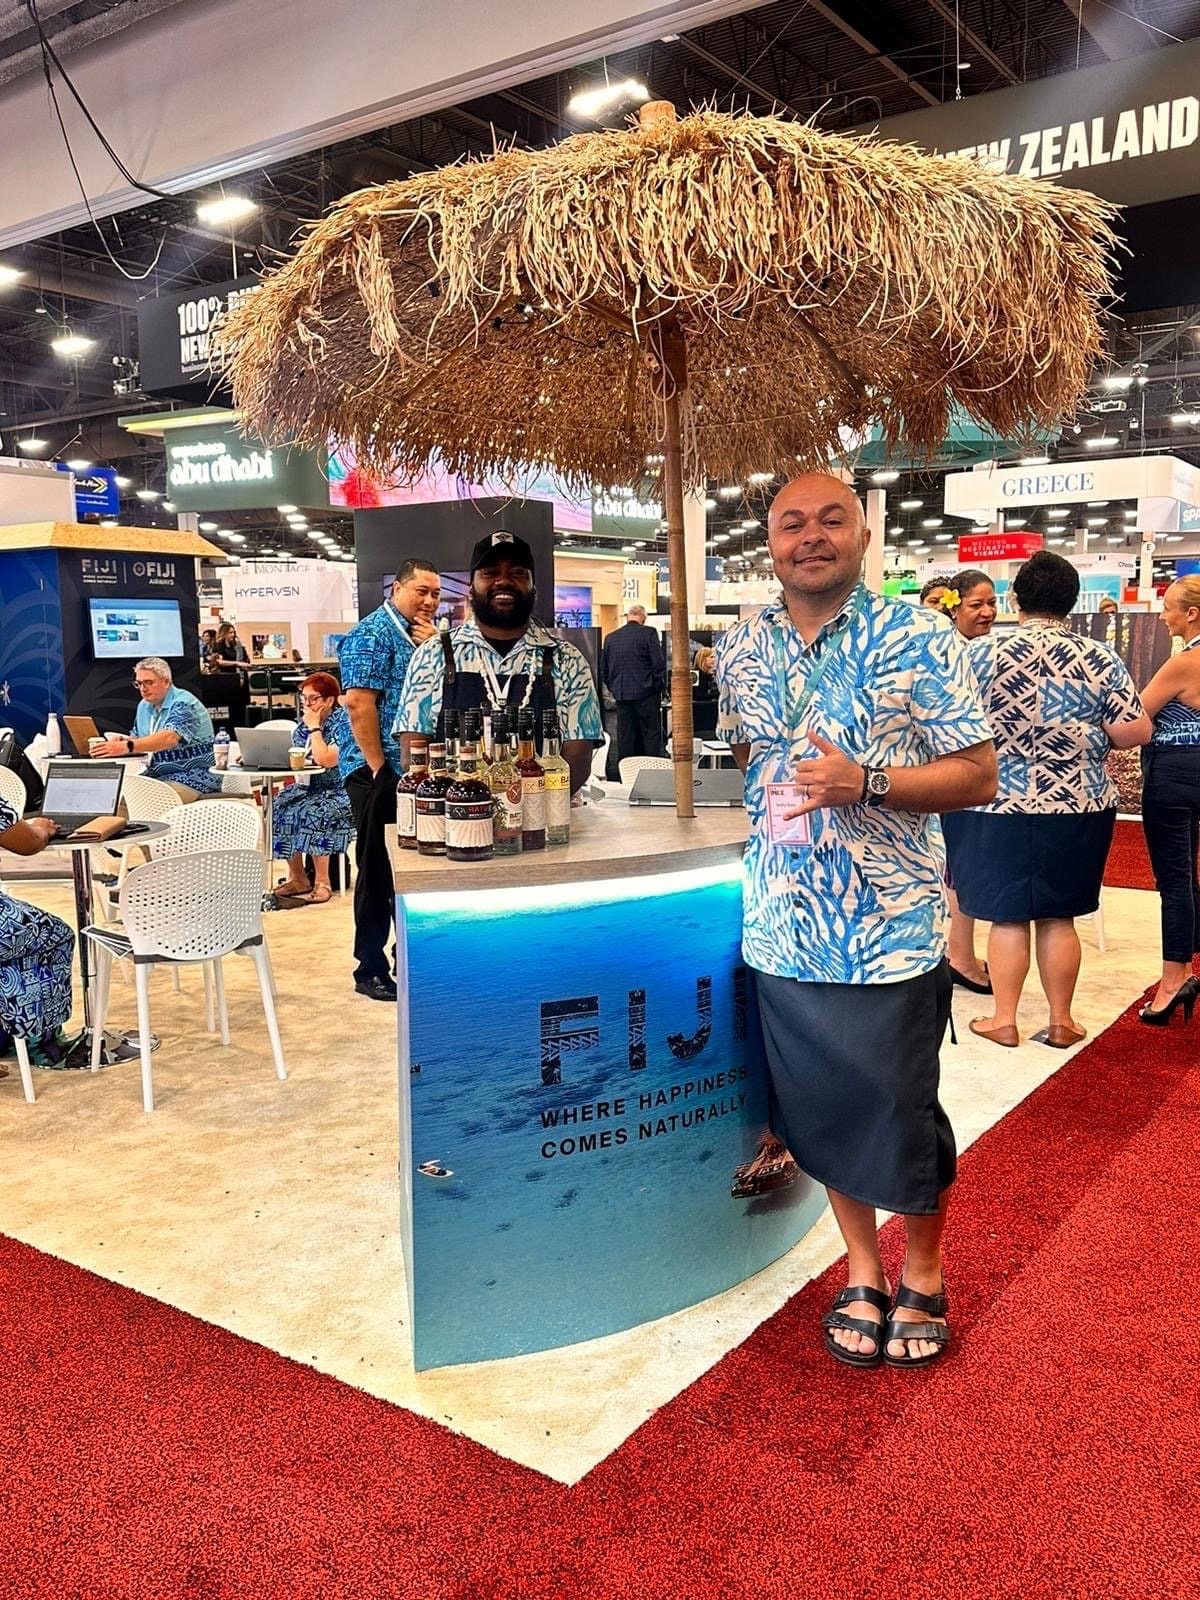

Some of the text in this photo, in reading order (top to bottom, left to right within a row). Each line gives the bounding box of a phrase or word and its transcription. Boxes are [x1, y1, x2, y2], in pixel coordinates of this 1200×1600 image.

[1018, 96, 1199, 178] ZEALAND
[1002, 472, 1094, 496] GREECE
[82, 559, 117, 574] FIJI
[146, 561, 175, 578] FIJI
[235, 586, 300, 598] HYPERVSN
[540, 966, 747, 1087] FIJI
[541, 1066, 748, 1128] WHERE HAPPINESS
[541, 1092, 747, 1159] COMES NATURALLY
